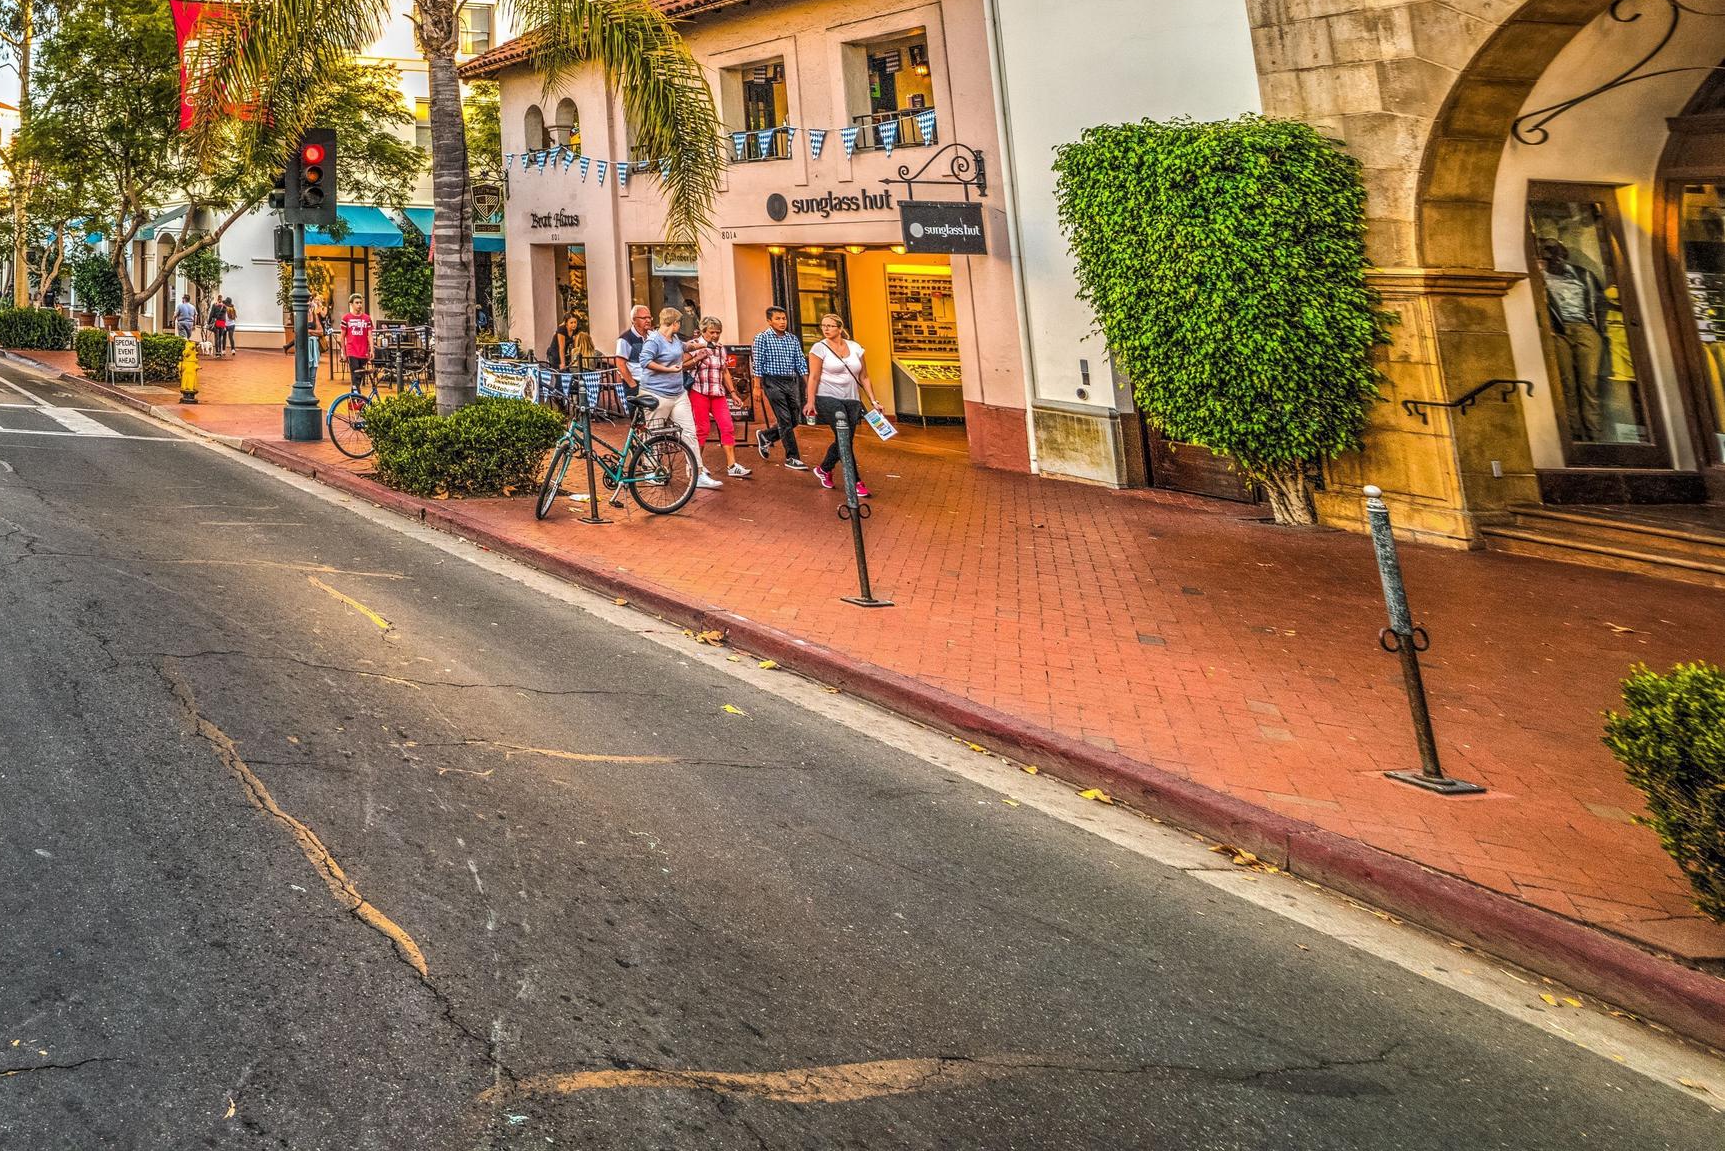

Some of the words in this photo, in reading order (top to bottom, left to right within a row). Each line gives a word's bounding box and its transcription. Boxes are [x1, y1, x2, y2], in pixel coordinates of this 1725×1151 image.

[791, 190, 860, 218] sunglass
[861, 188, 894, 210] hut
[924, 223, 964, 238] sunglass
[964, 224, 981, 236] hut
